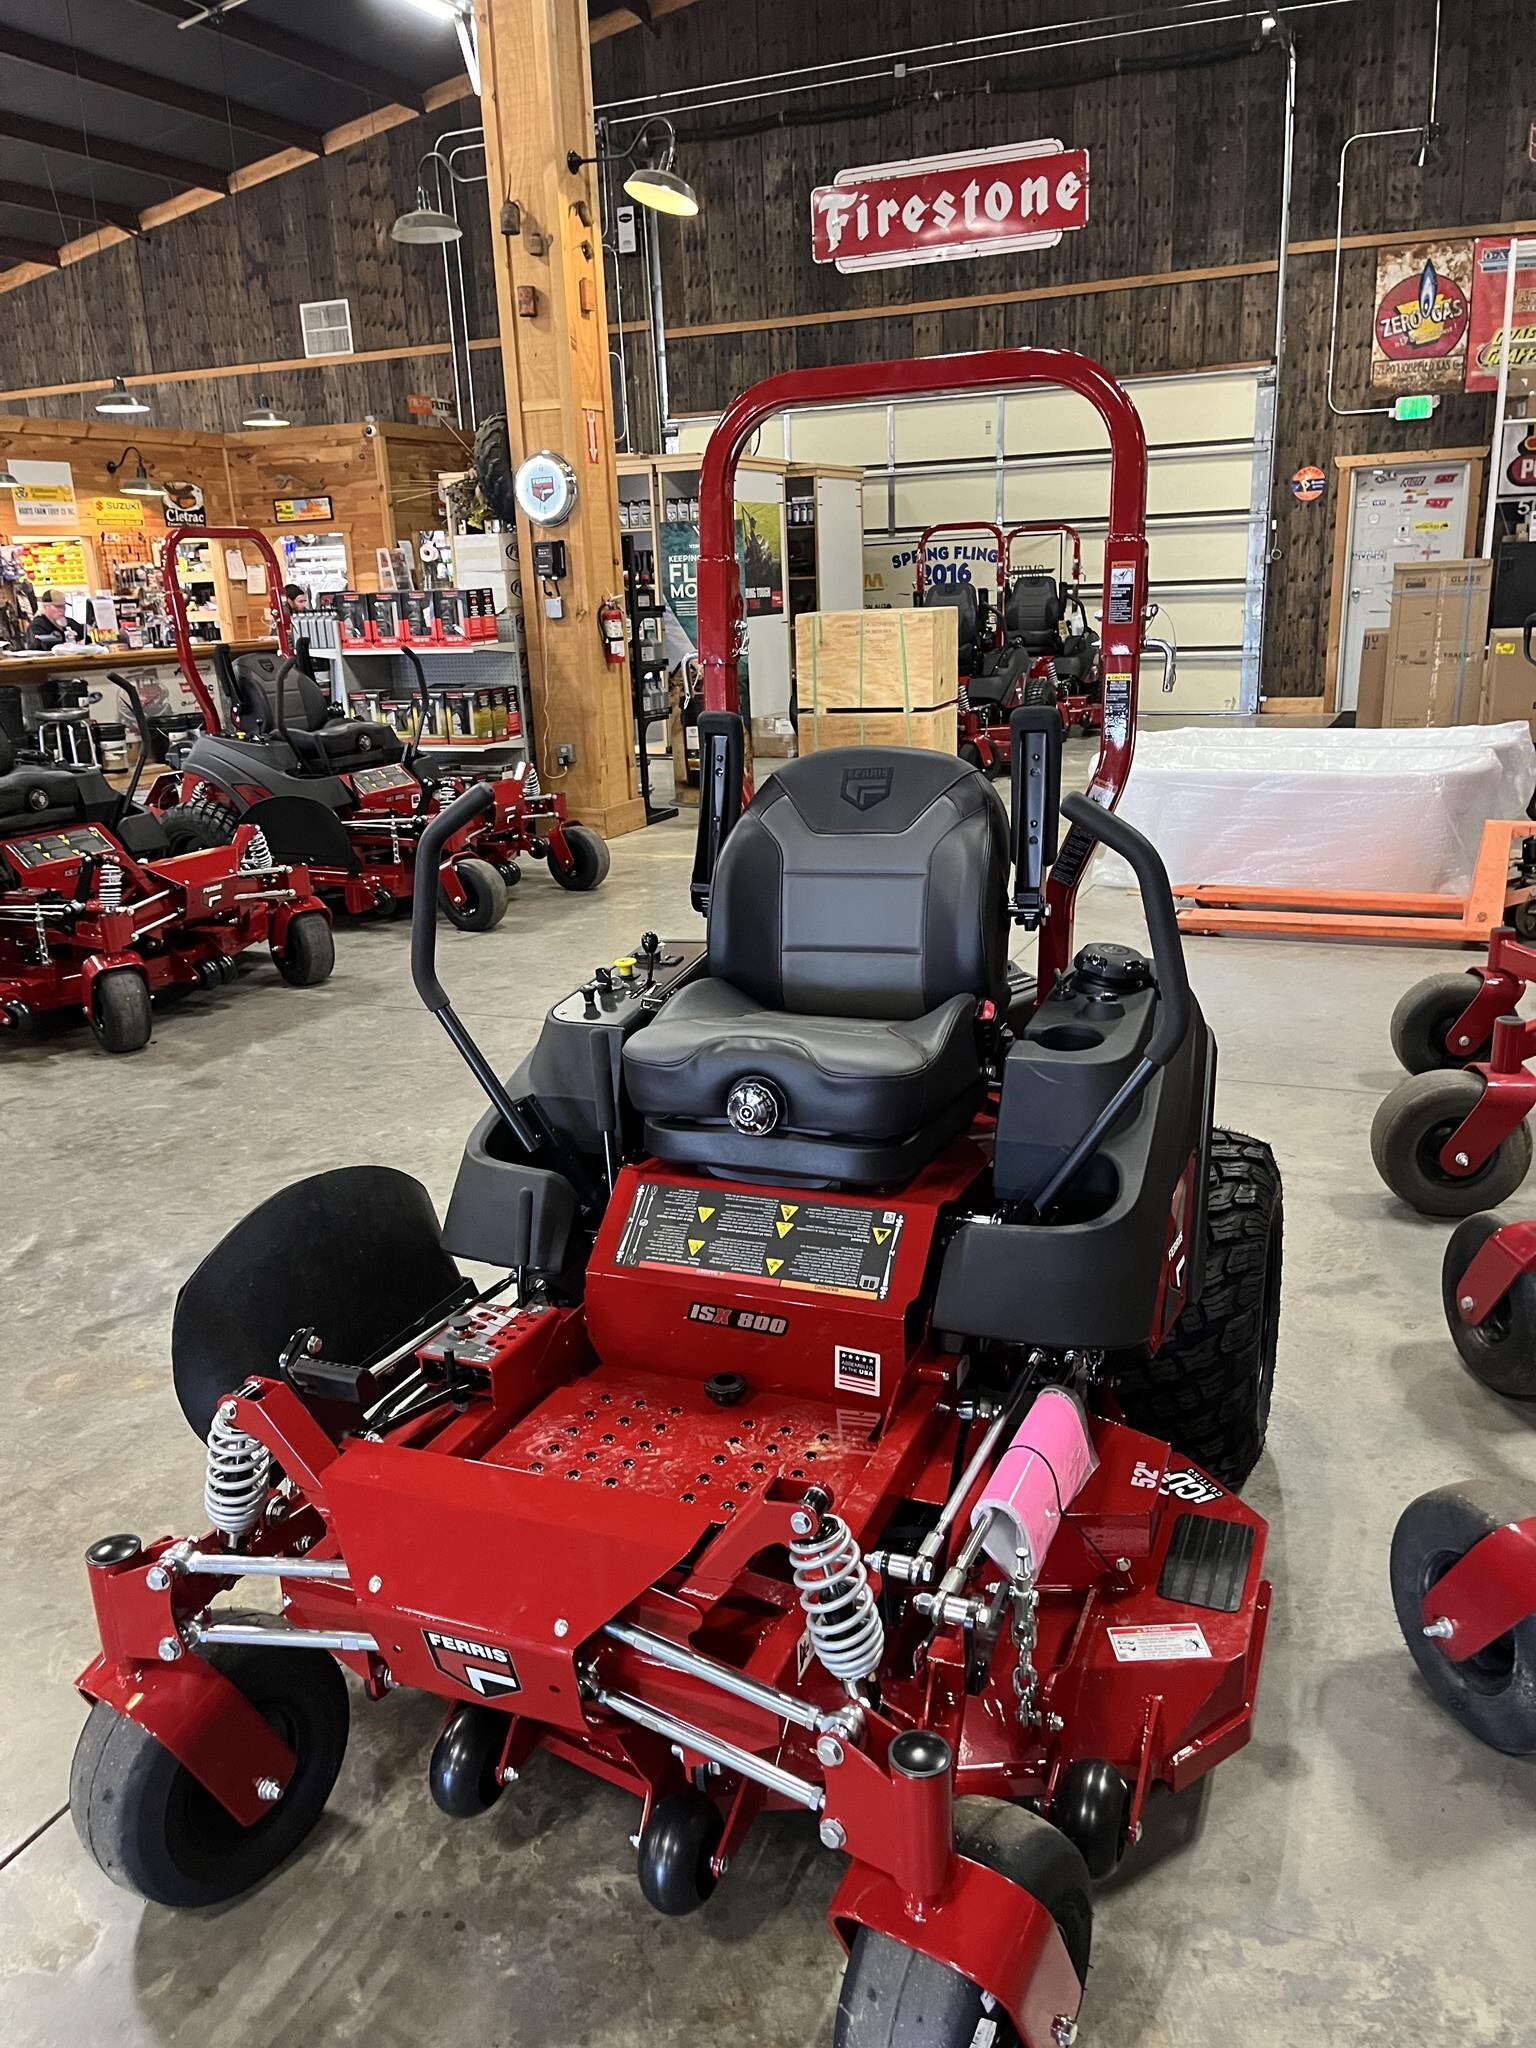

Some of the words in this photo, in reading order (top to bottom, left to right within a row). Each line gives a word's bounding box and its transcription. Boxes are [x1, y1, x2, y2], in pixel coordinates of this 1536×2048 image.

[818, 172, 1082, 252] Firestone
[1381, 312, 1423, 338] ZERO
[1431, 299, 1463, 323] GAS
[106, 502, 140, 510] SUZUKI
[166, 509, 204, 523] Cletrac
[954, 546, 999, 563] FLING
[924, 563, 972, 586] 2016
[690, 1304, 732, 1325] ISX
[737, 1313, 787, 1334] 800
[841, 1361, 874, 1370] ASSEMBLED
[859, 1369, 874, 1377] USA
[1130, 1461, 1159, 1489] 52"
[1187, 1468, 1223, 1497] CUTTING
[428, 1632, 508, 1663] FERRIS
